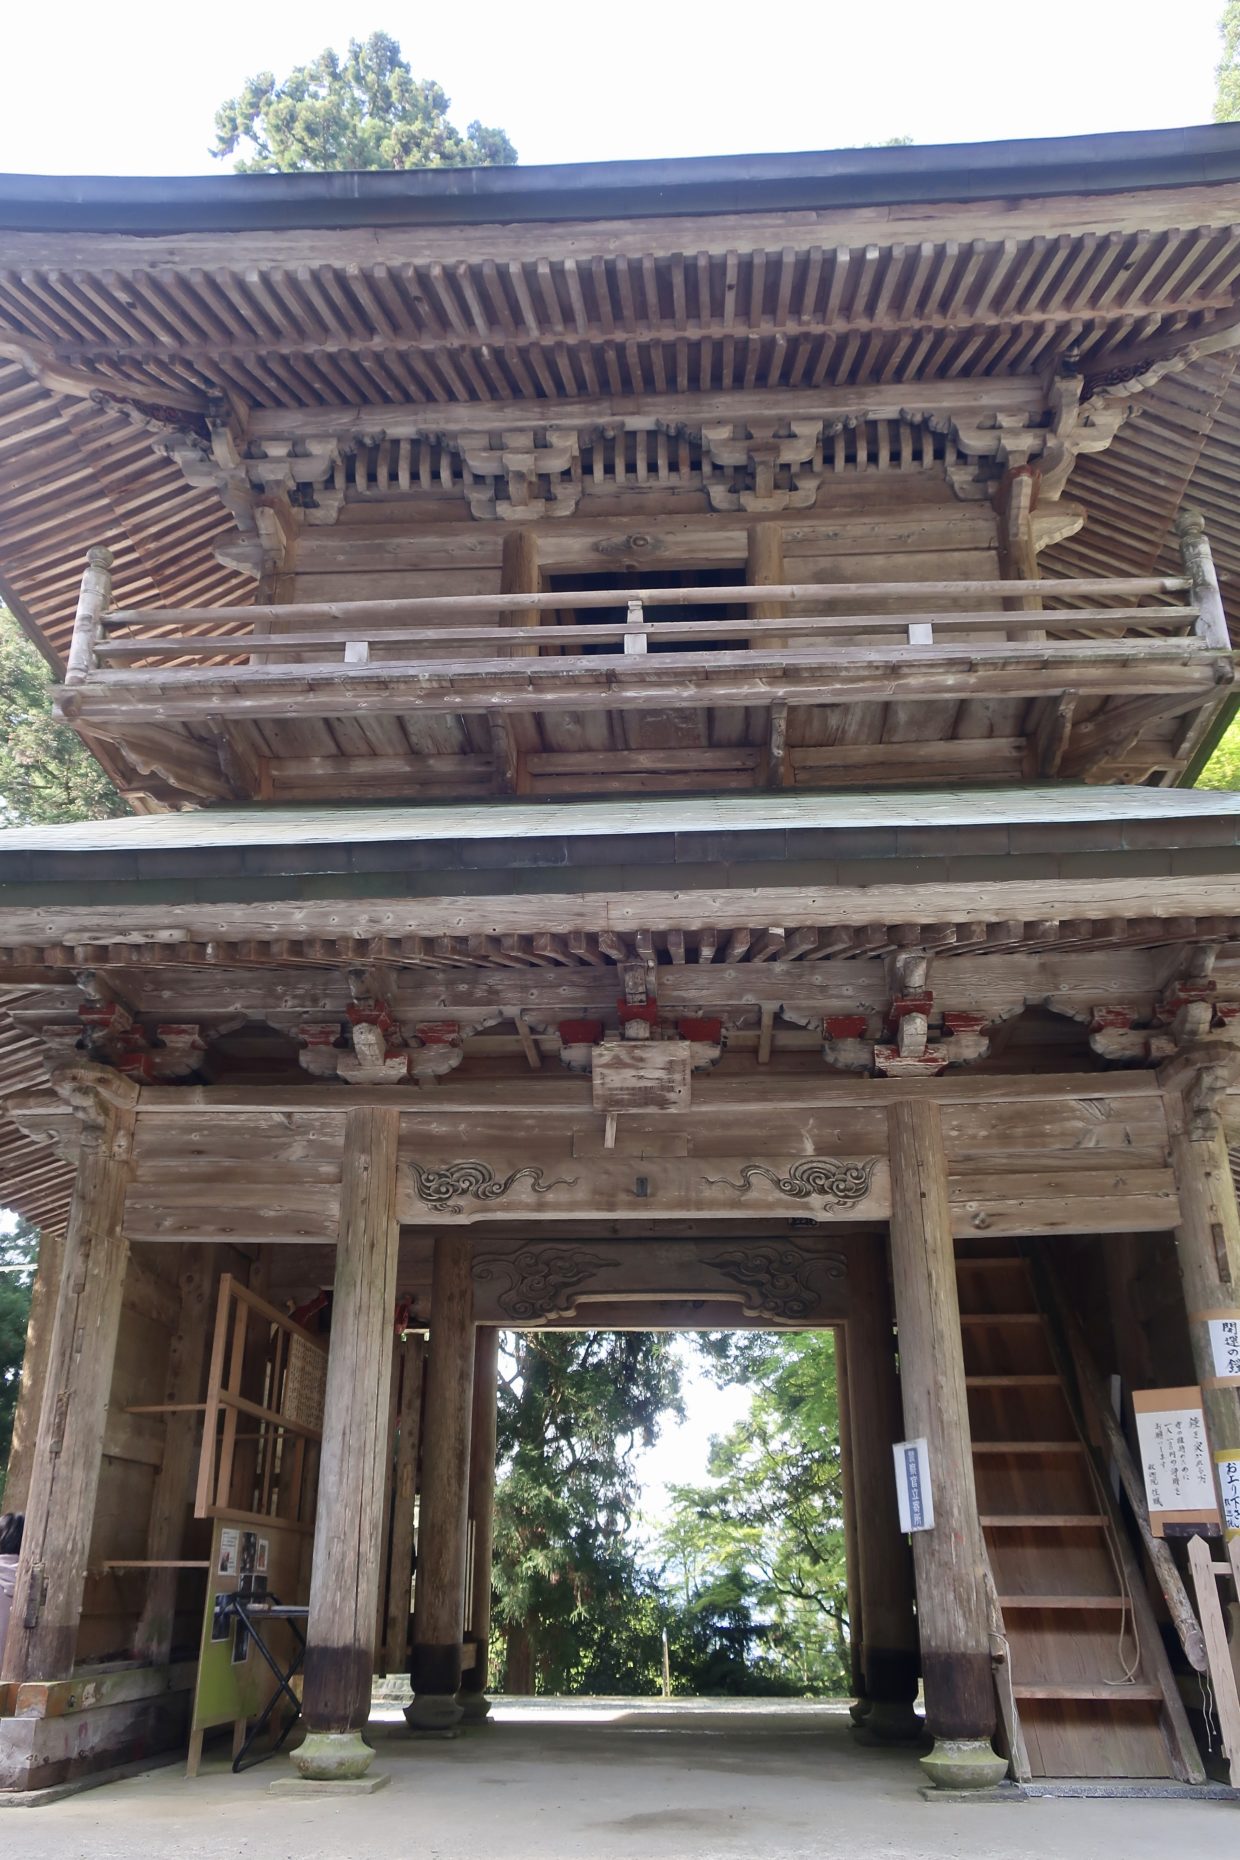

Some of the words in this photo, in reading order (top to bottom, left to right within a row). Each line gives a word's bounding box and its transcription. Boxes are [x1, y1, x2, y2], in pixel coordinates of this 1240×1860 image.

[907, 1450, 922, 1526] 警察官立寄所
